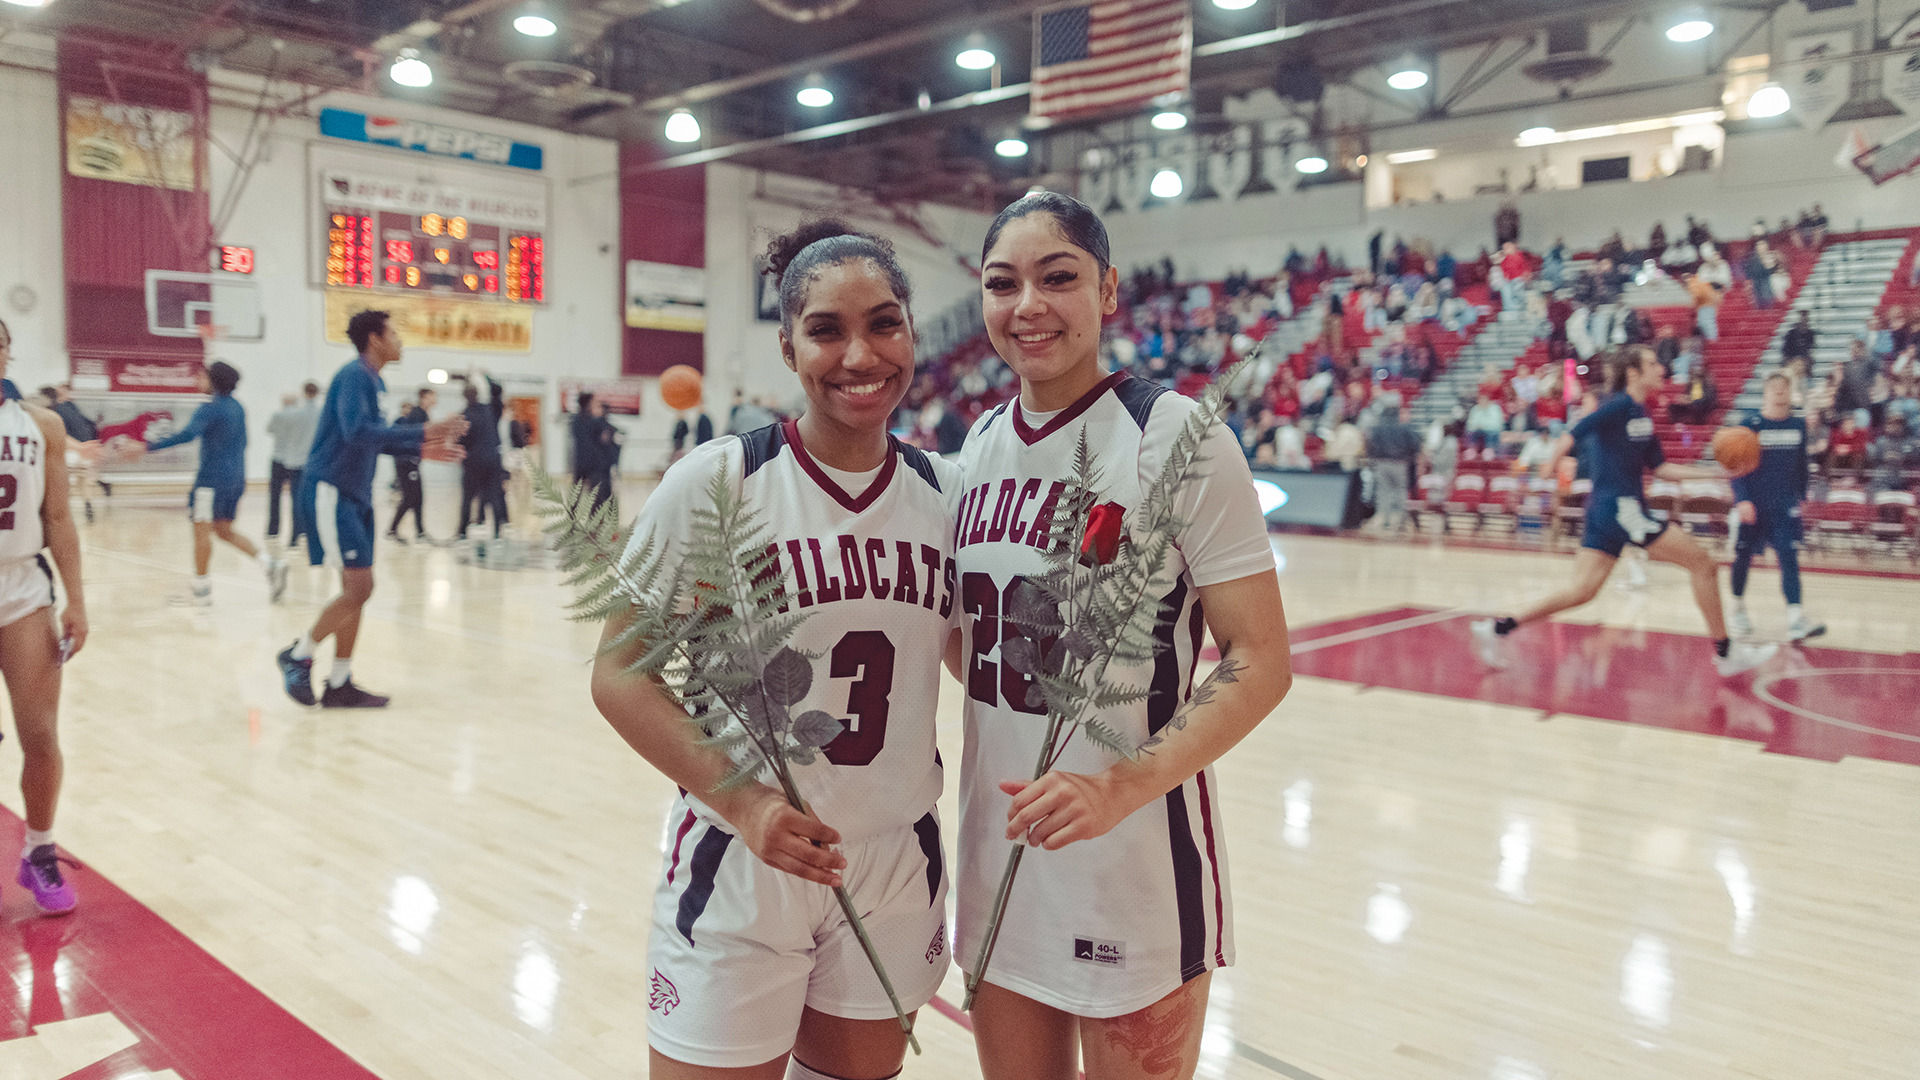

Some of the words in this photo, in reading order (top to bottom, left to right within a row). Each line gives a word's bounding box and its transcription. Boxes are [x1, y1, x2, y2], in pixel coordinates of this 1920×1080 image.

[401, 121, 513, 165] PEPSI
[221, 246, 254, 273] 30
[820, 631, 896, 766] 3
[1097, 944, 1119, 955] 40-L
